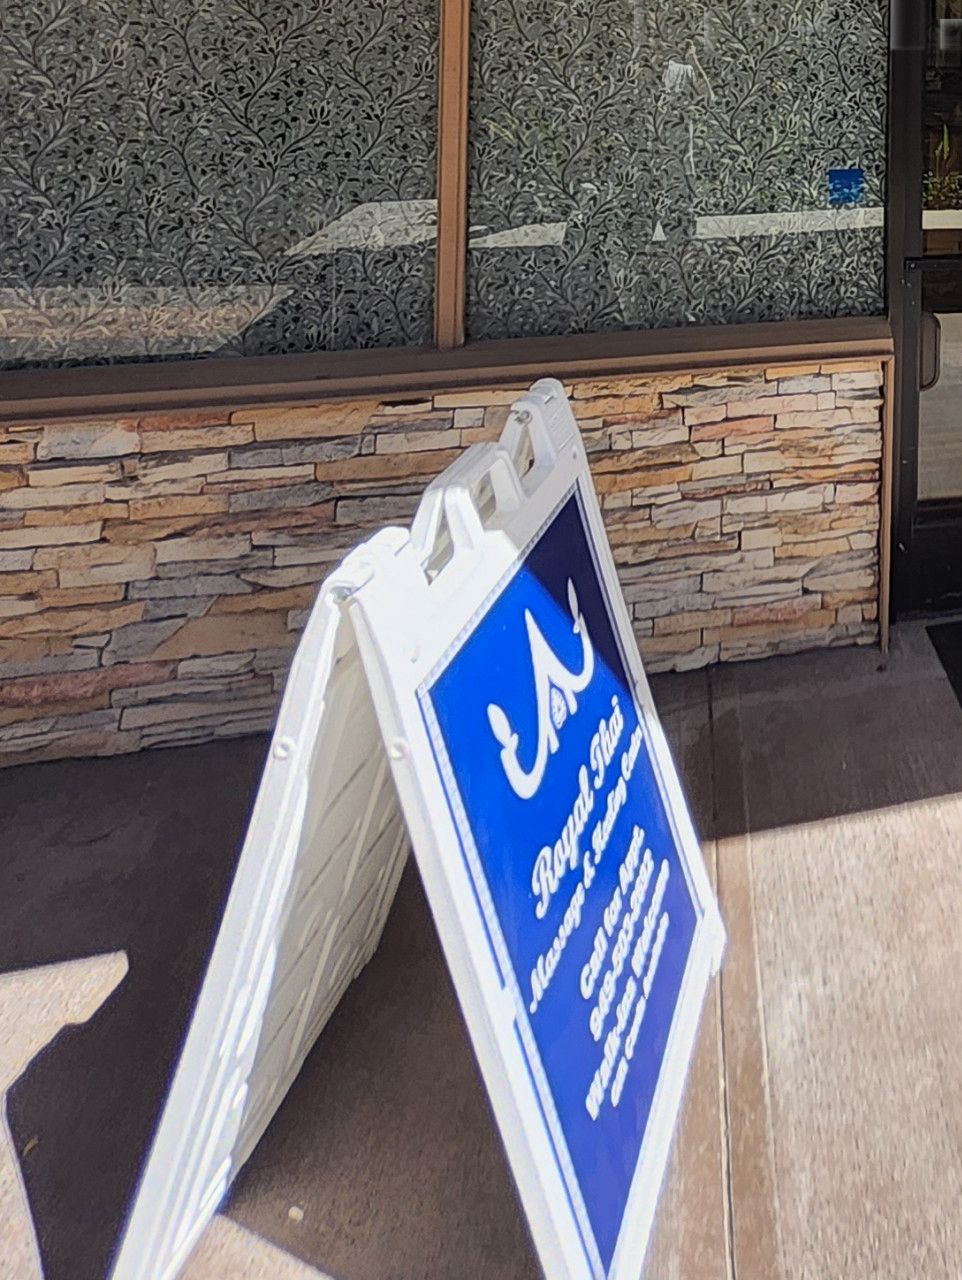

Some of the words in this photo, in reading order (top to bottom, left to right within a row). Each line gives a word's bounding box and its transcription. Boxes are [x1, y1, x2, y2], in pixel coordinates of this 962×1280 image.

[529, 882, 586, 1014] Massage
[583, 850, 596, 889] &
[592, 776, 627, 864] Healing
[532, 764, 594, 919] Royal
[590, 694, 624, 790] Thai
[580, 926, 608, 1000] Call
[603, 886, 622, 937] for
